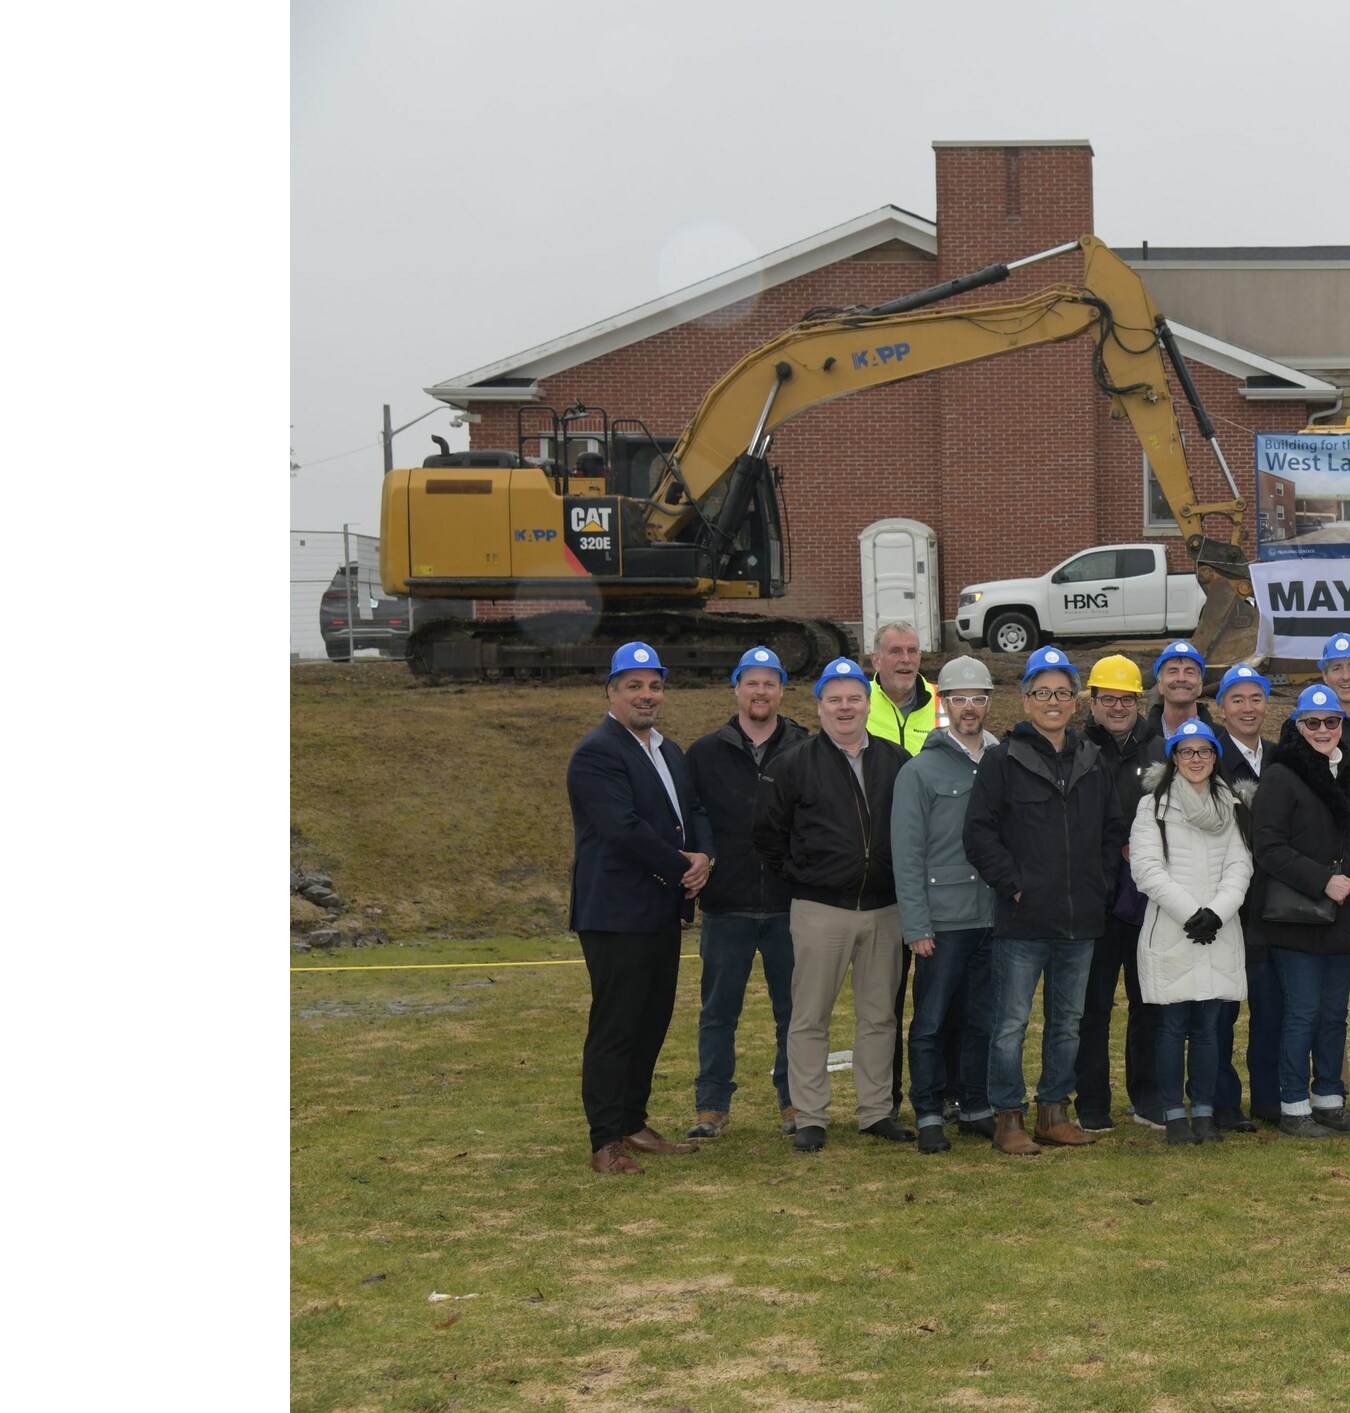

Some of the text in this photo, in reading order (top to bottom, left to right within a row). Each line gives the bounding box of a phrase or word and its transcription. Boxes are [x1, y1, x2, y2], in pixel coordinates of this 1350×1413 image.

[1264, 439, 1317, 453] Building
[1320, 438, 1339, 450] for
[1265, 452, 1321, 471] West
[571, 507, 612, 532] CAT
[580, 537, 611, 550] 320E
[1064, 593, 1108, 609] HBNG
